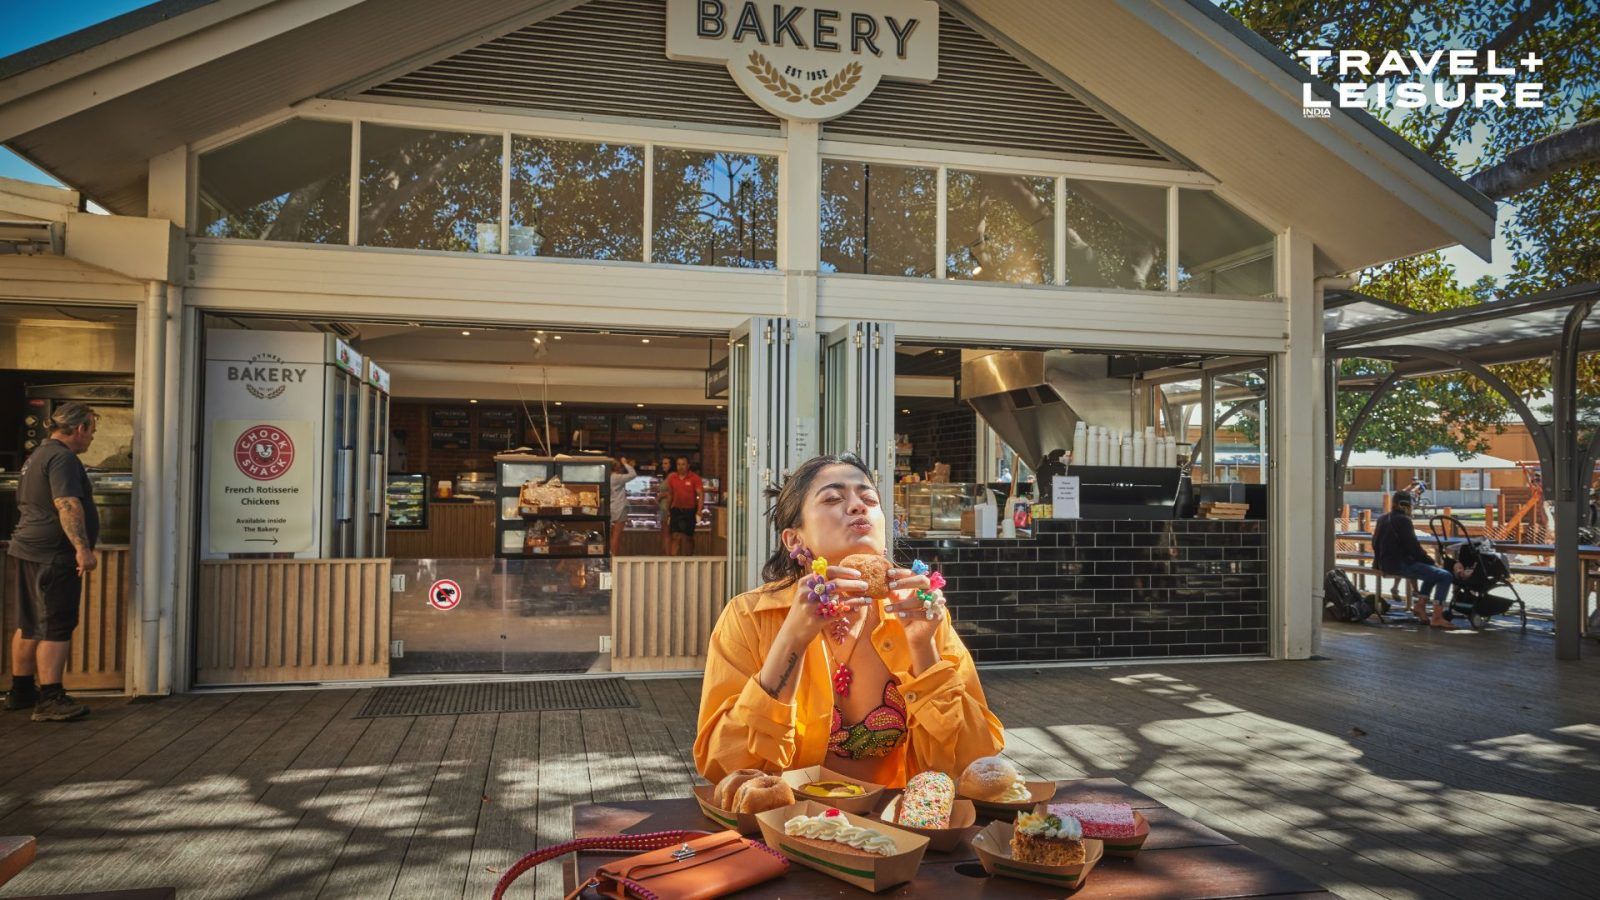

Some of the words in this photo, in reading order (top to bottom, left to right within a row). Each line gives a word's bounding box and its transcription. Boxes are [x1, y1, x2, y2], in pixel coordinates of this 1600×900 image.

[696, 0, 920, 59] BAKERY
[785, 65, 802, 79] EST
[807, 69, 828, 81] 1952
[227, 366, 307, 382] BAKERY
[241, 430, 288, 449] CHOOK
[242, 458, 287, 476] SHACK
[225, 486, 254, 494] French
[256, 486, 299, 494] Rotisserie
[241, 498, 280, 506] Chickens
[257, 526, 279, 534] Bakery
